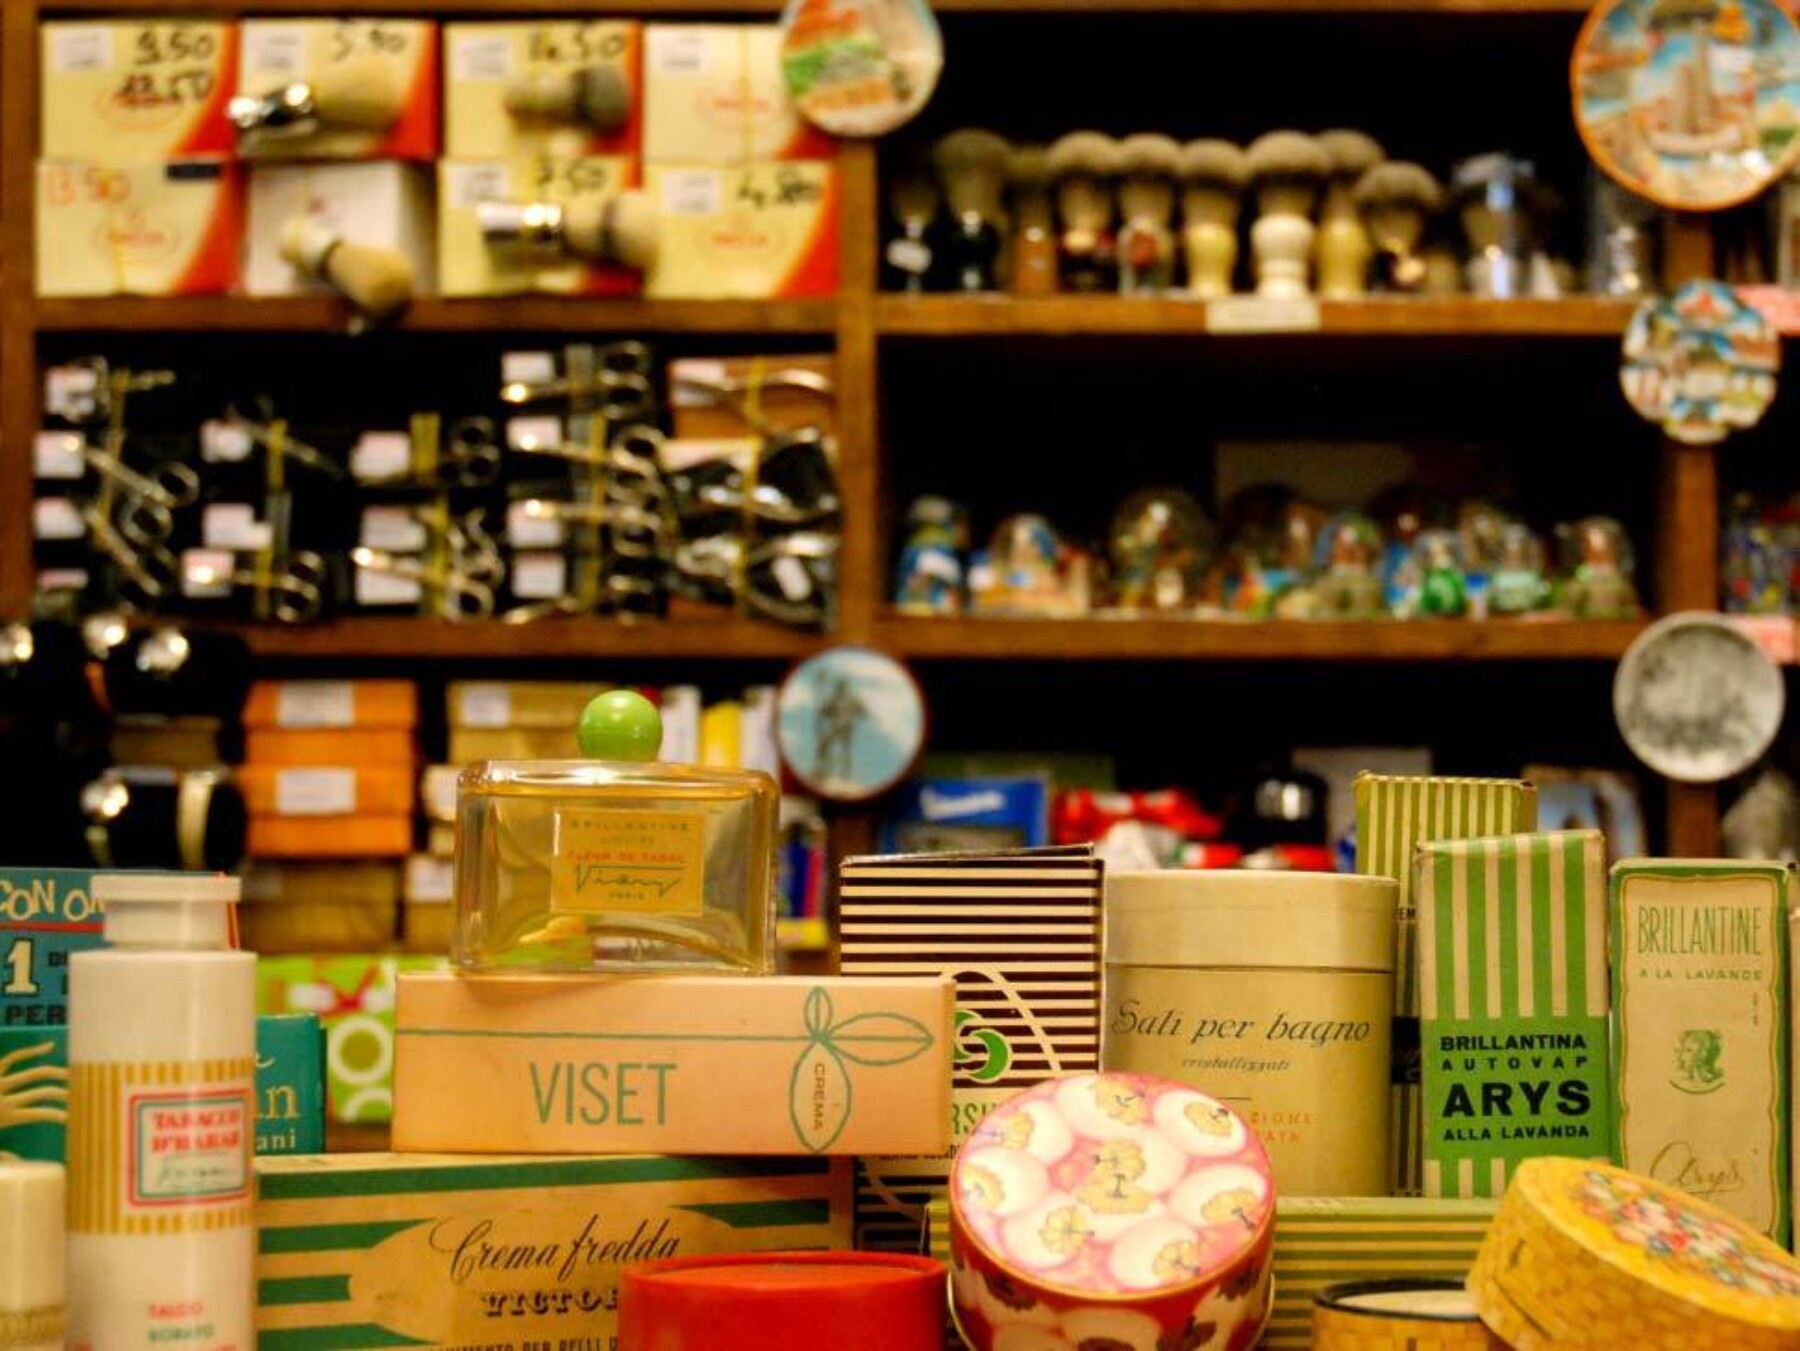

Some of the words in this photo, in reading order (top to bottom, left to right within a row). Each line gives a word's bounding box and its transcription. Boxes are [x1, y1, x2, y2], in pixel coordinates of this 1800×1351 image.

[1637, 905, 1762, 956] BRILLANTINE
[3, 938, 40, 997] 1
[1686, 968, 1762, 981] LAVANDE
[1111, 999, 1183, 1037] Sali
[1191, 1017, 1254, 1045] per
[1266, 1013, 1373, 1047] bagno
[1440, 1033, 1588, 1052] BRILLANTINA
[528, 1061, 678, 1126] VISET
[811, 1062, 826, 1132] CREMA
[1441, 1079, 1592, 1118] ARYS
[1442, 1126, 1492, 1142] ALLA
[1501, 1123, 1590, 1140] LAVANDA
[429, 1216, 557, 1286] Crema
[556, 1214, 680, 1284] fredda
